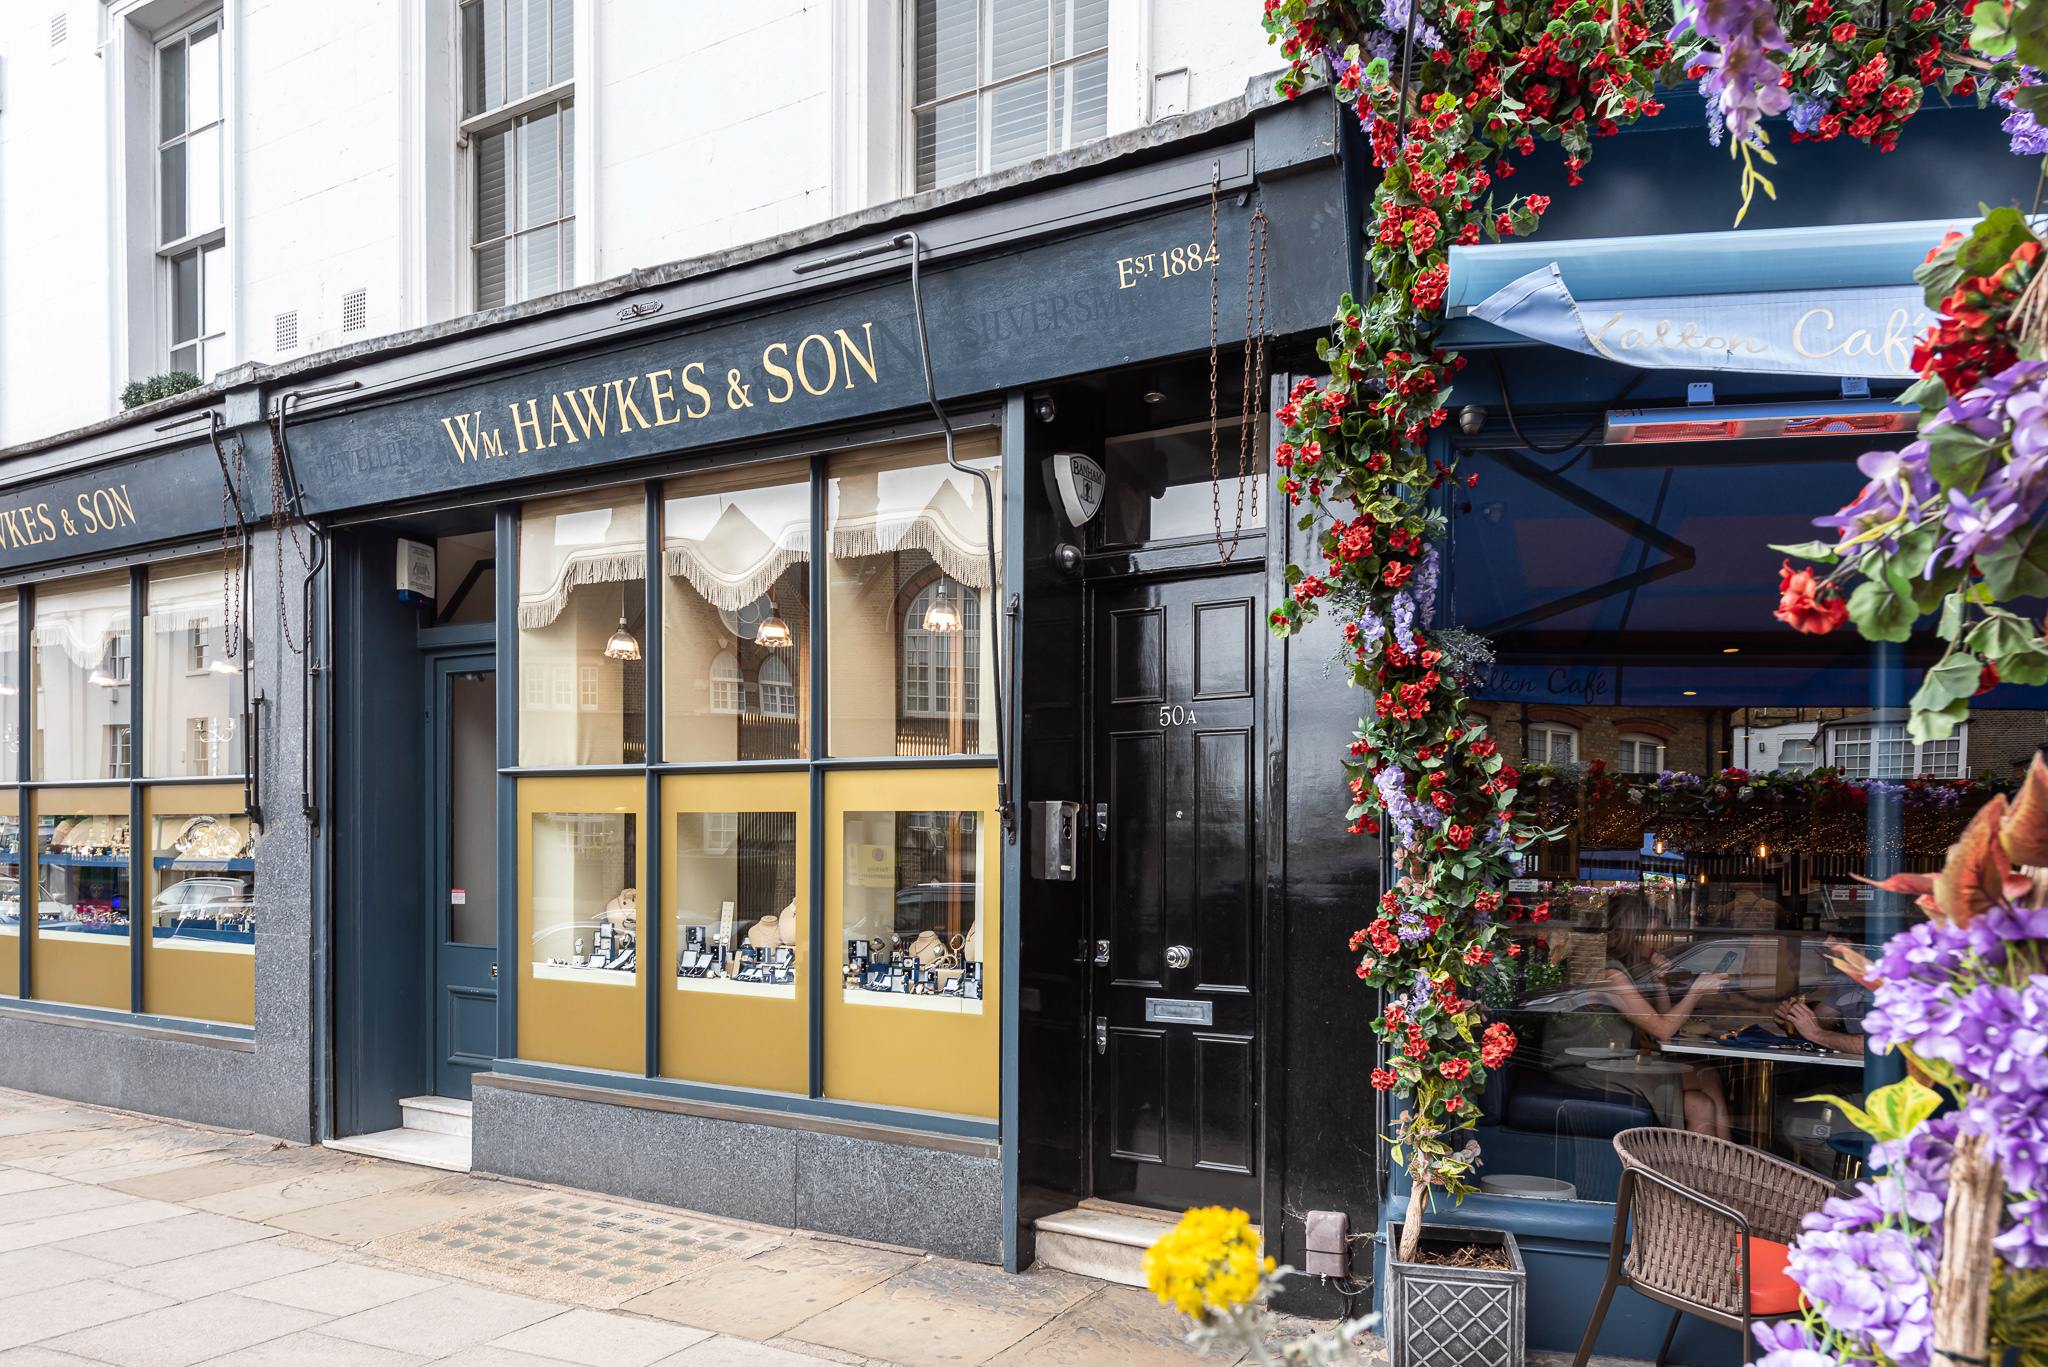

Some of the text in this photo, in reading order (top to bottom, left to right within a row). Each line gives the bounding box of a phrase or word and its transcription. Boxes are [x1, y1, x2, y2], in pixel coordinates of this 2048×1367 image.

[1160, 240, 1220, 279] 1884
[510, 362, 711, 454] HAWKES
[727, 369, 754, 410] &
[763, 322, 878, 404] SON
[1073, 460, 1102, 483] BANHAM
[61, 509, 79, 537] &
[77, 485, 137, 533] SON
[1547, 667, 1608, 705] Café
[1159, 705, 1199, 727] 50A
